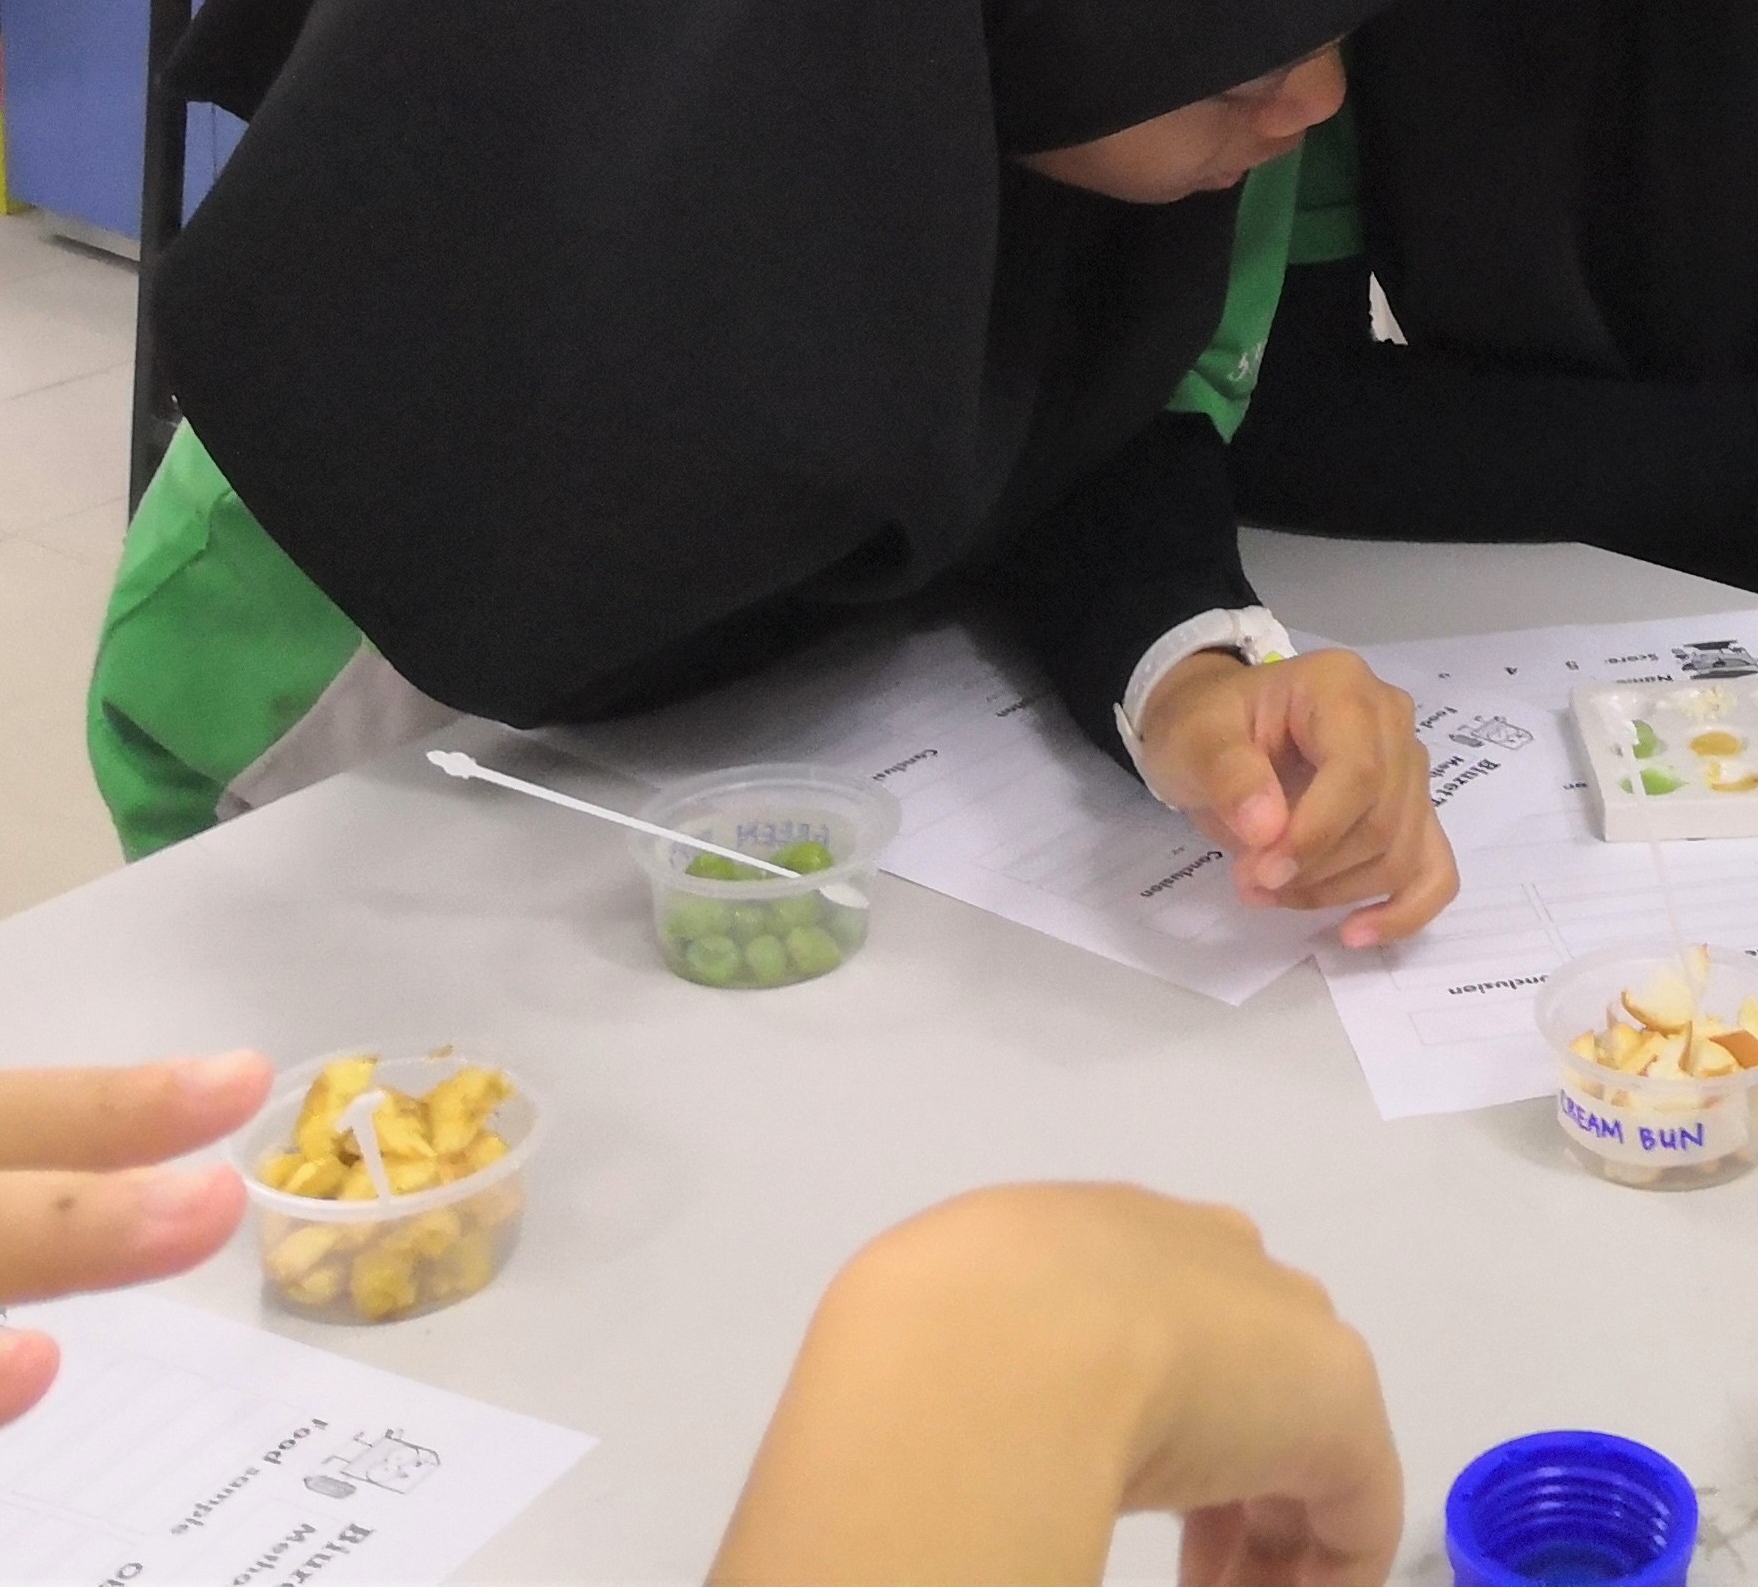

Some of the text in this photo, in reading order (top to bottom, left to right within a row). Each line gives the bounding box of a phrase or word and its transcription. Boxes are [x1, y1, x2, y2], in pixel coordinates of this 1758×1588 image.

[1638, 1123, 1704, 1151] BUN
[171, 1417, 329, 1536] Food sample
